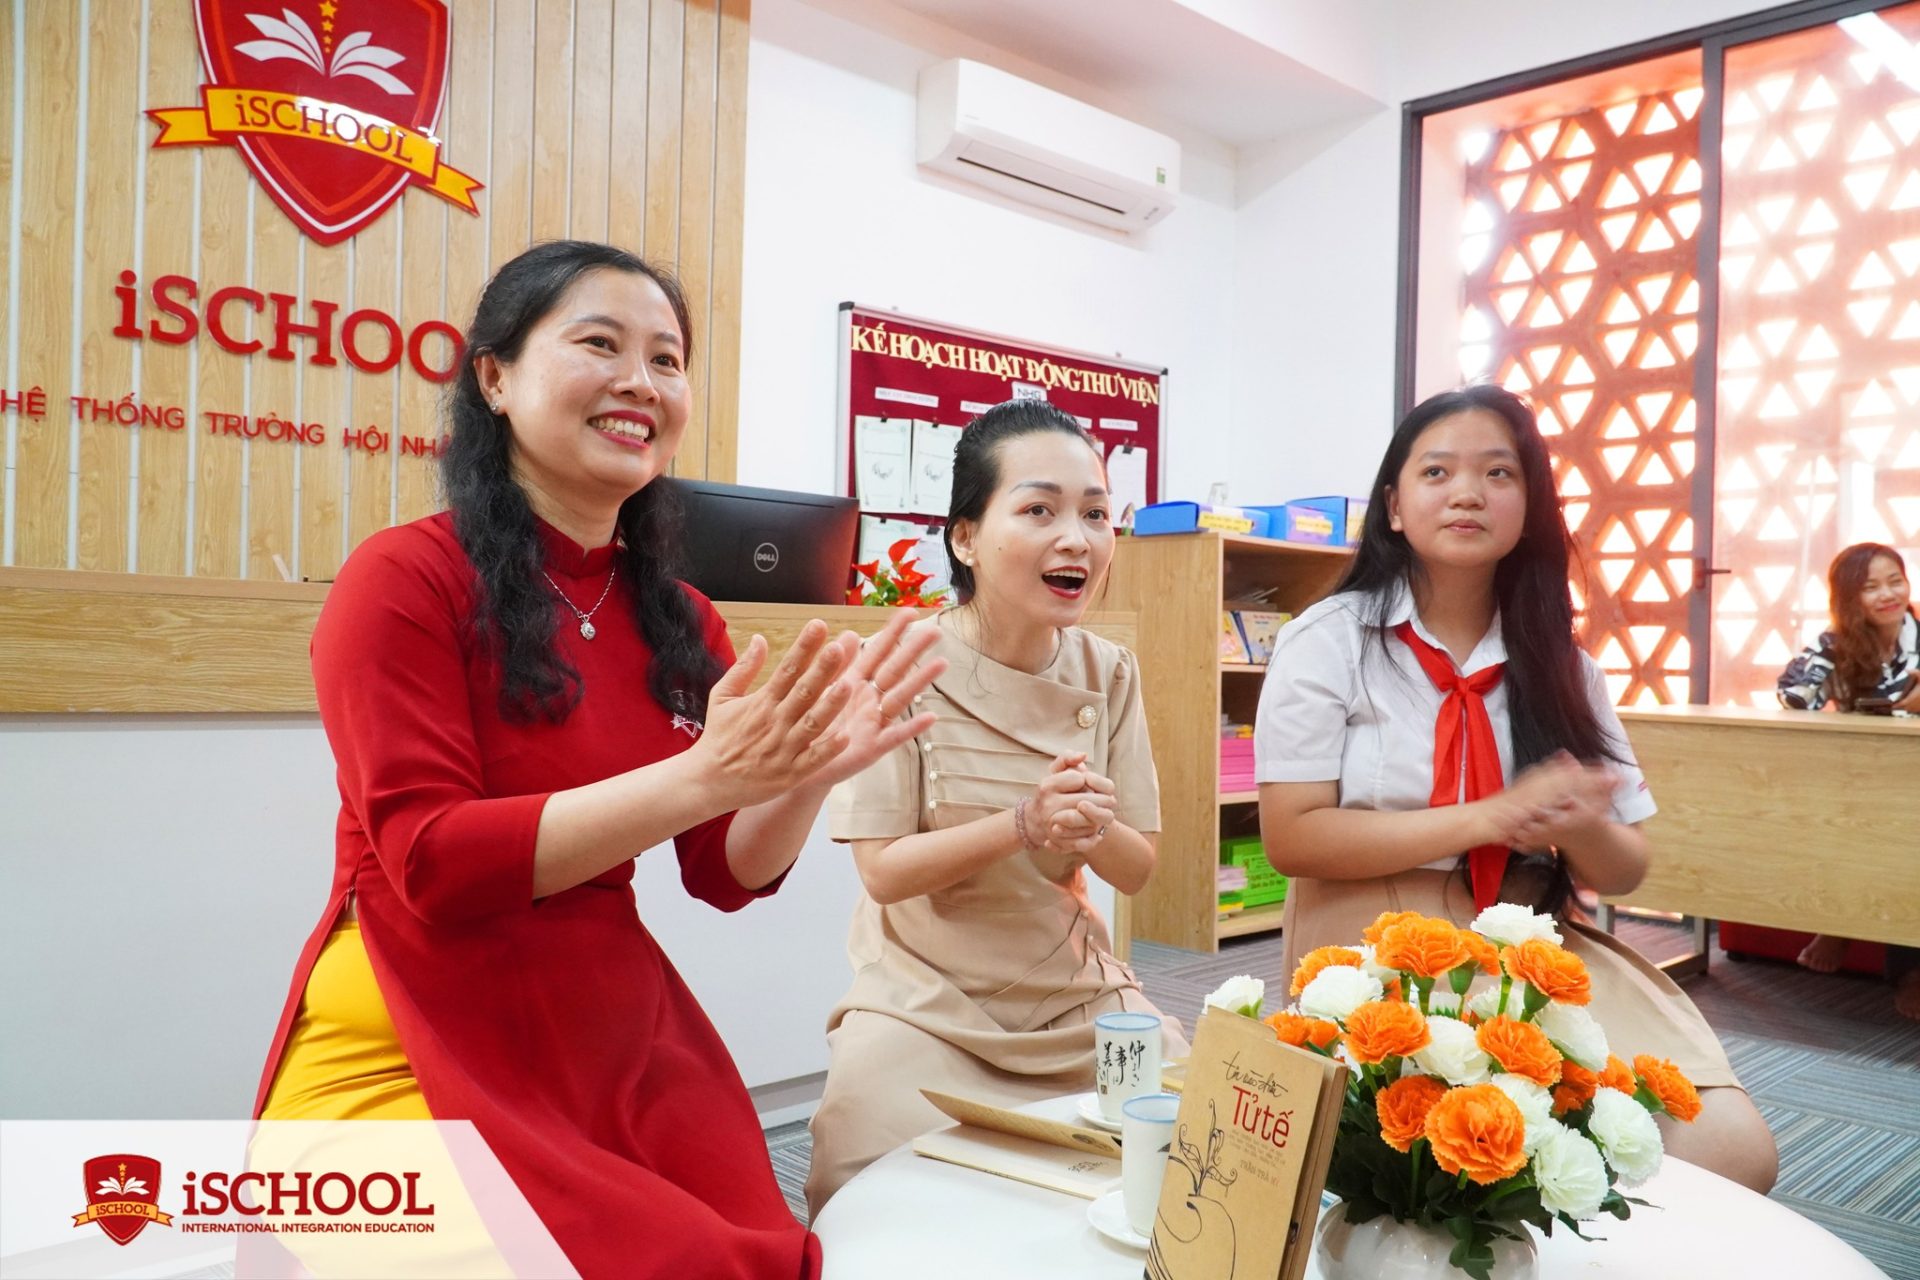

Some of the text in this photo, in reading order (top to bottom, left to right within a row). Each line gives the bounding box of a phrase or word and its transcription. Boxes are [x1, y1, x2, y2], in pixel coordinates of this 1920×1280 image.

[235, 94, 413, 163] iSCHOOL
[851, 322, 1160, 408] KẾ HOẠCH HOẠT ĐỘNG THƯ VIỆN
[0, 386, 47, 423] HỆ
[70, 392, 186, 431] THỐNG
[204, 411, 325, 446] TRƯỜNG
[342, 424, 389, 457] HỘI
[756, 553, 776, 561] DELL
[1232, 1085, 1262, 1134] Tử
[1261, 1105, 1294, 1148] tế
